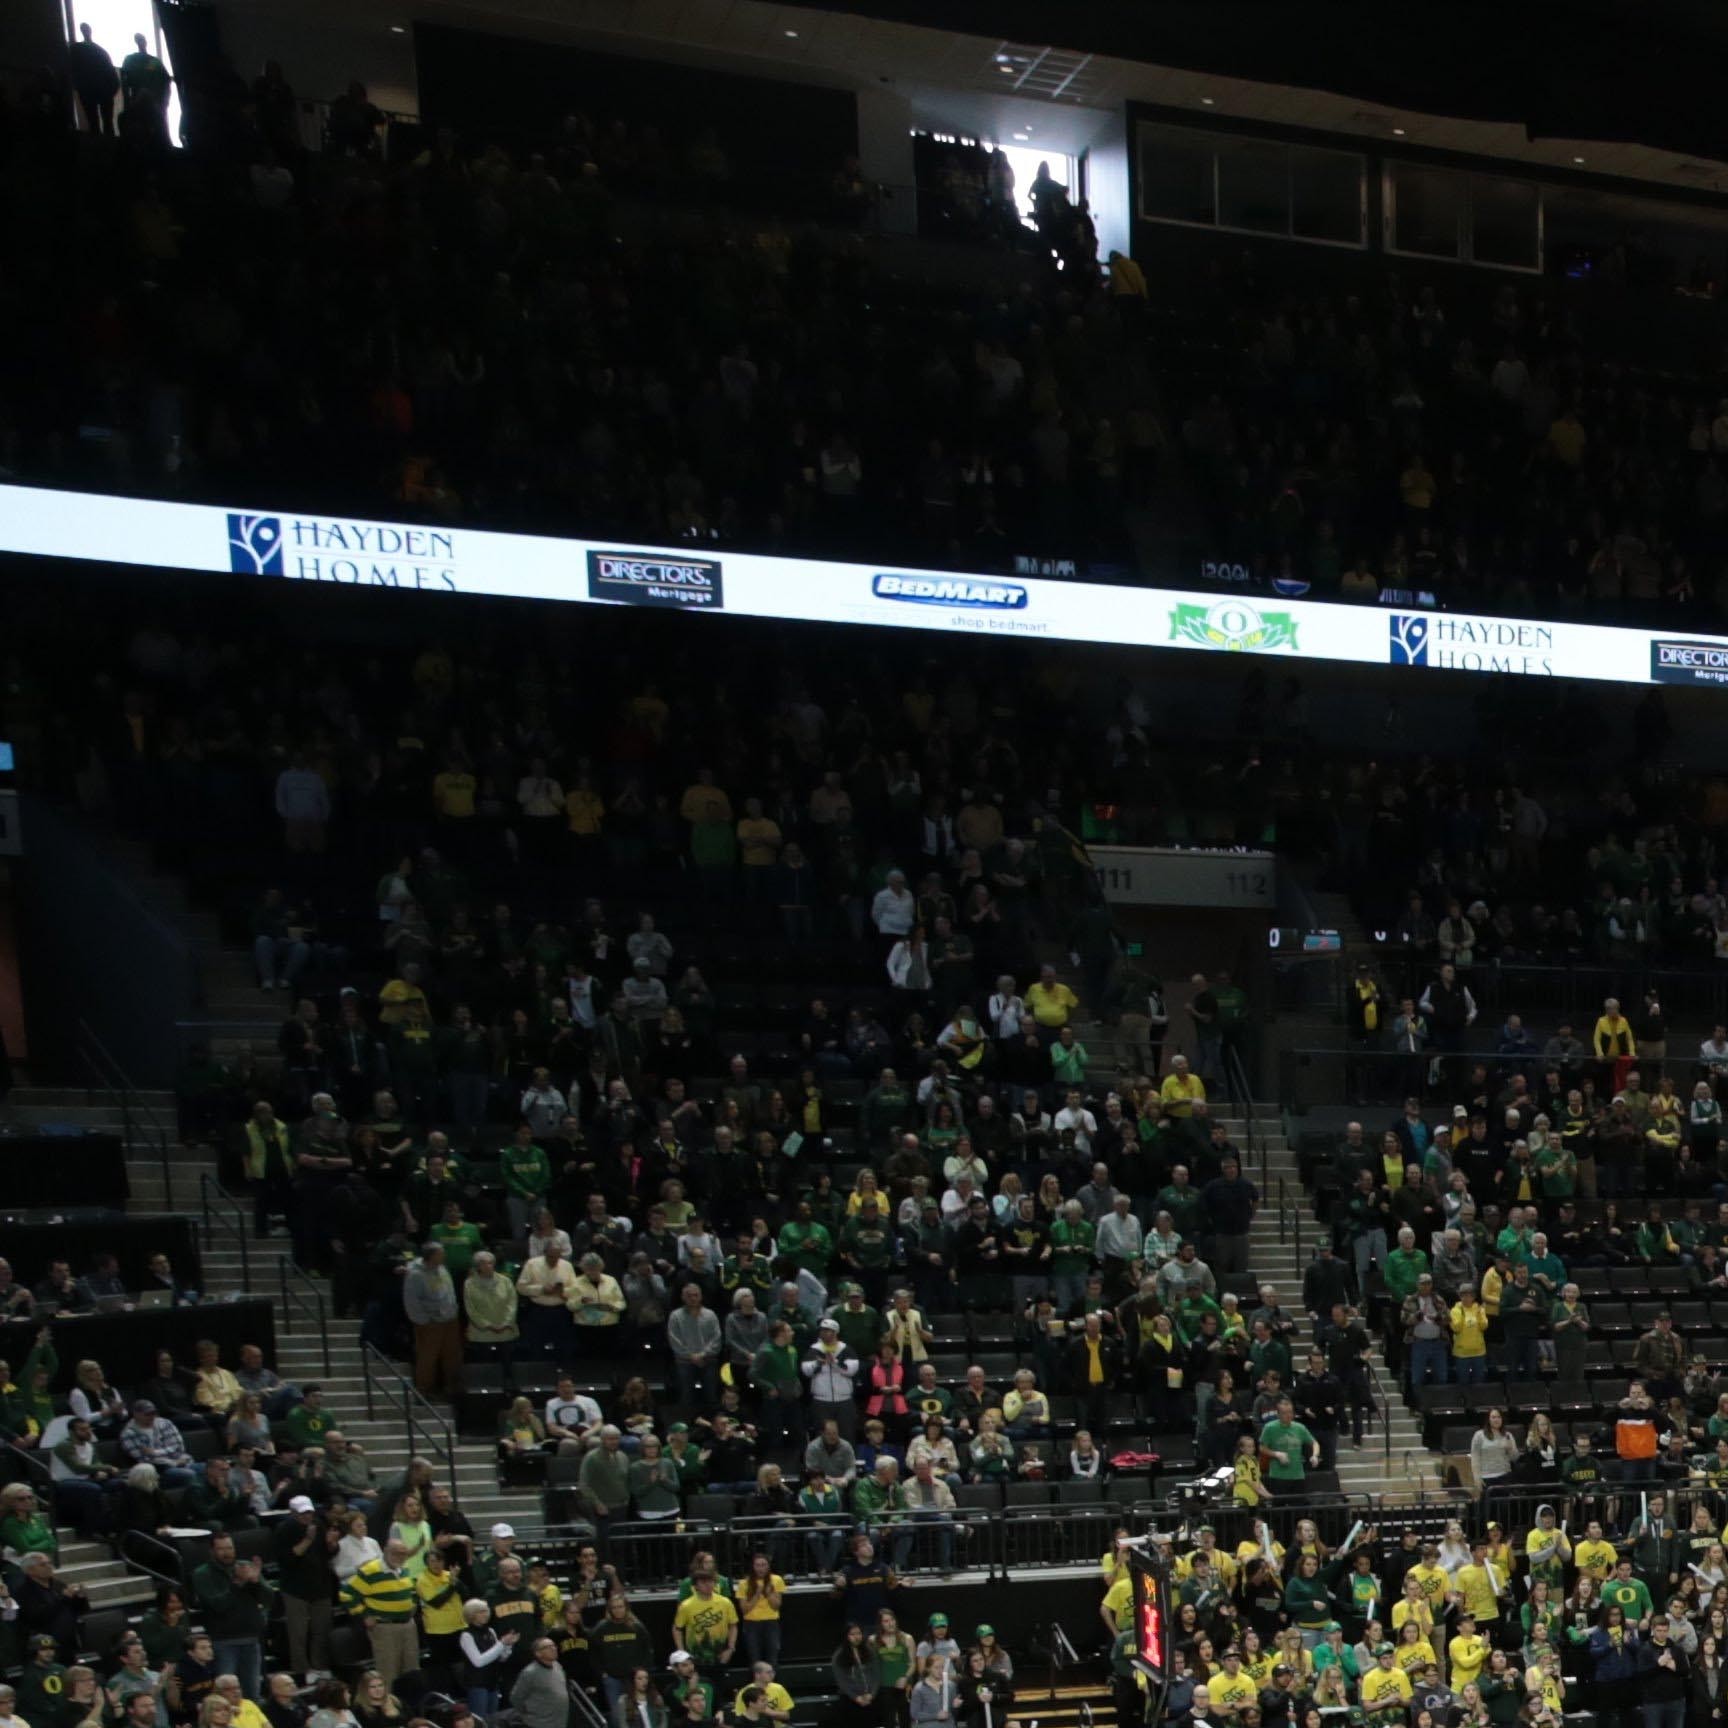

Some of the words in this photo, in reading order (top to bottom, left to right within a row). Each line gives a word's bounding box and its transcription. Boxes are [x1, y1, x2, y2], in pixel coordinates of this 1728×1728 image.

[293, 521, 455, 558] HAYDEN
[298, 557, 457, 591] HOMES
[648, 586, 713, 602] Mortgage
[1436, 619, 1552, 649] HAYDEN
[1438, 650, 1553, 677] HOMES
[1227, 872, 1266, 894] 112
